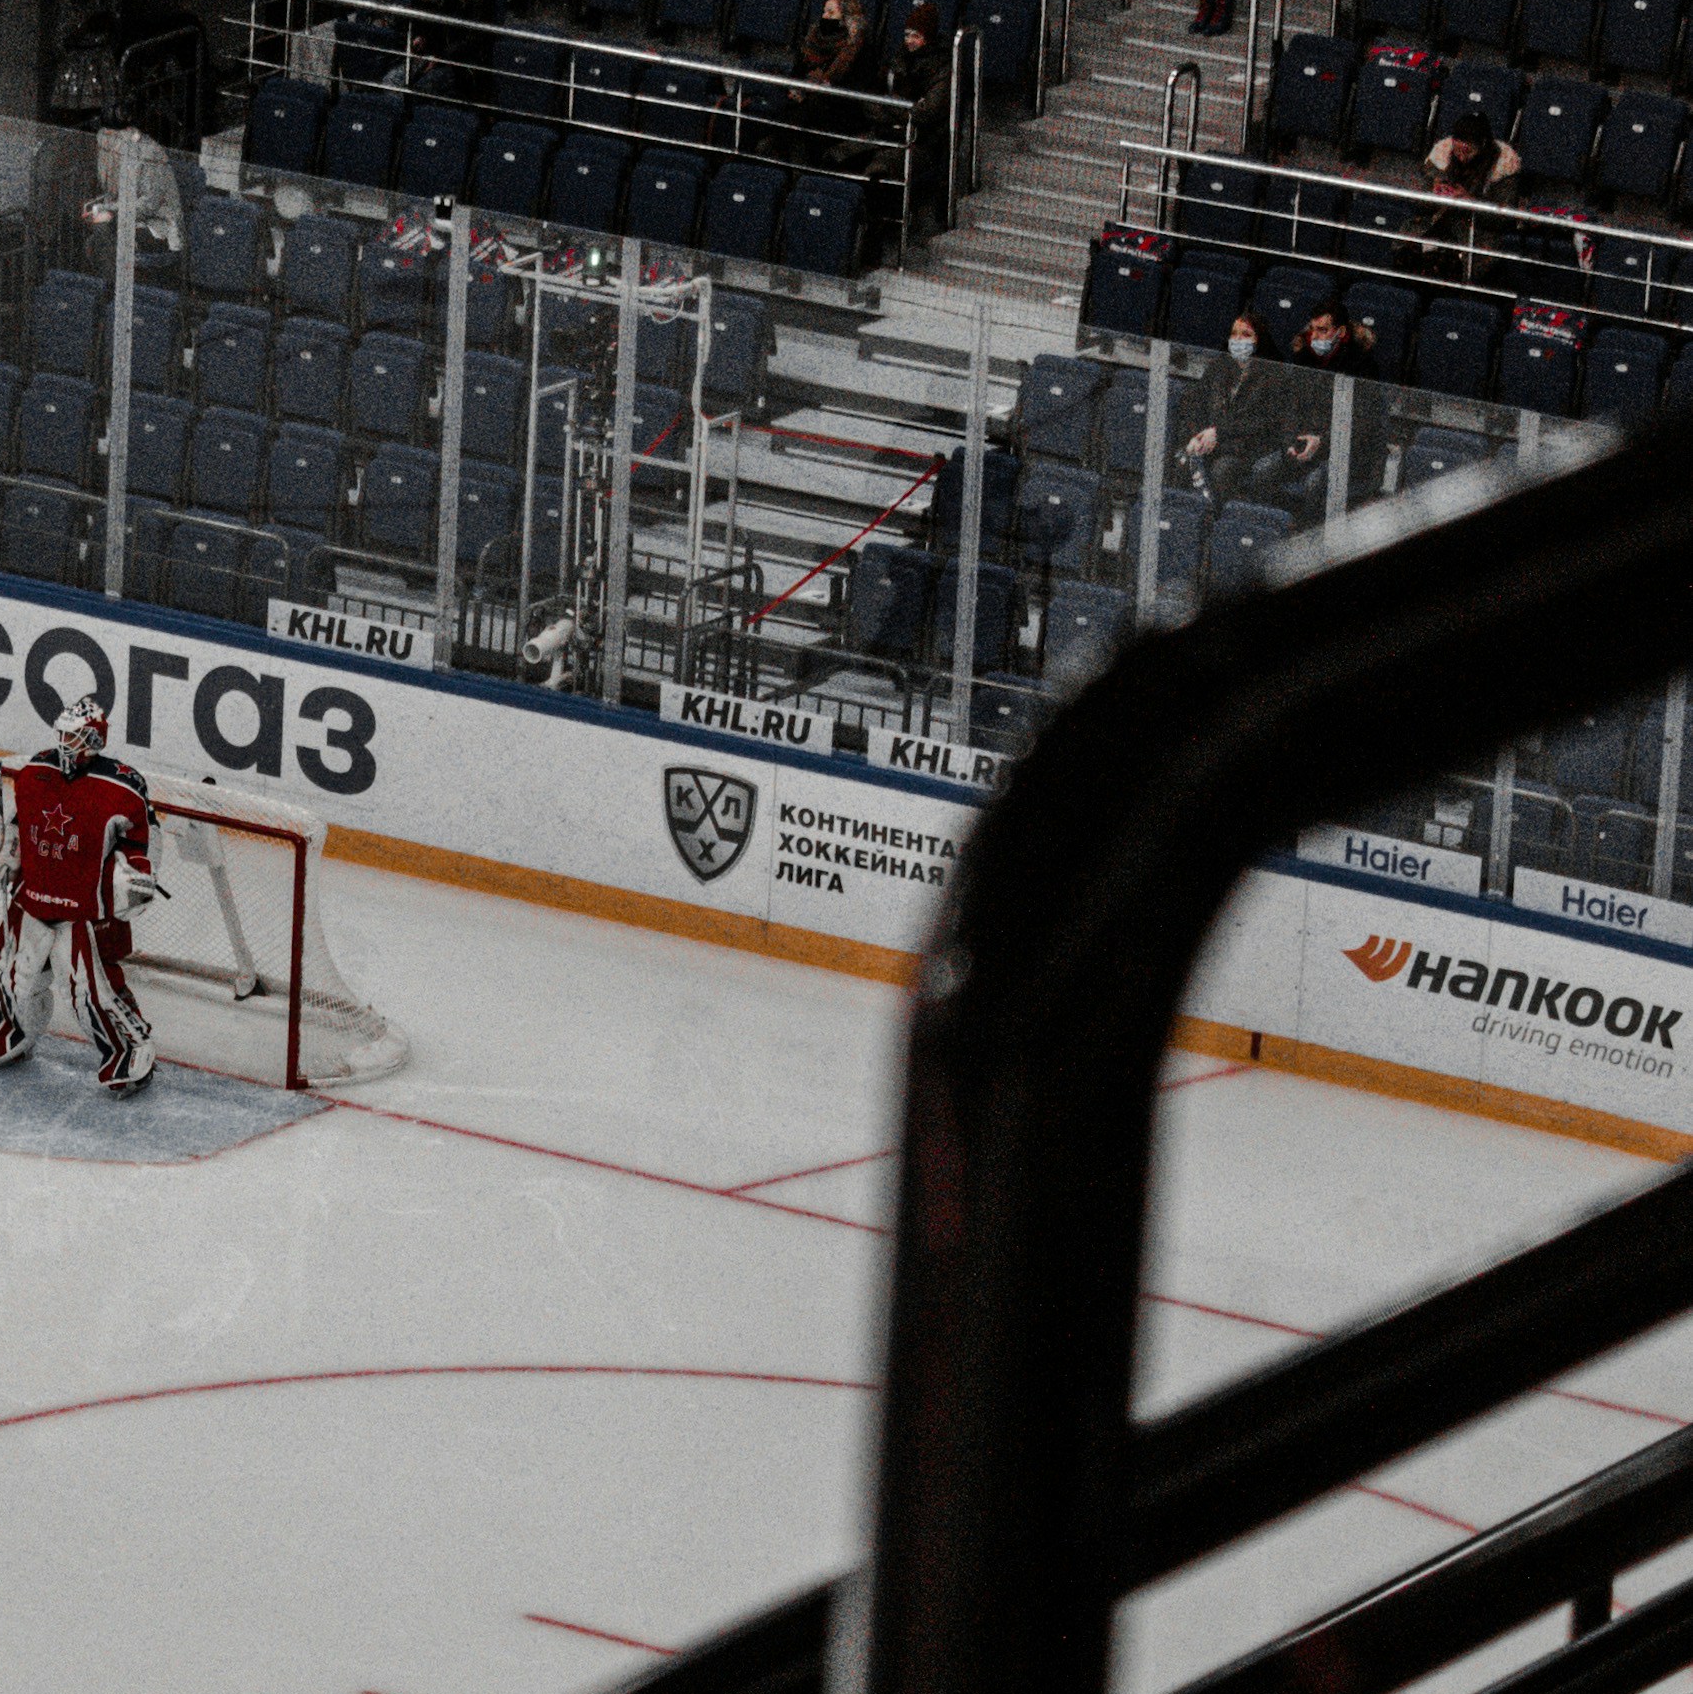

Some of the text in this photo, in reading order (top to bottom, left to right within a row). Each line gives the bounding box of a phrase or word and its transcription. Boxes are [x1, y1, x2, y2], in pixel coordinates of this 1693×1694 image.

[286, 610, 415, 661] KHL.RU
[680, 691, 812, 745] KHL.RU
[890, 737, 1011, 789] KHL.R
[29, 824, 80, 861] ЦСКА
[780, 804, 956, 859] КОНТИНЕНТА
[776, 862, 844, 894] ЛИГА
[778, 832, 945, 887] ХОККЕЙНАЯ
[1344, 836, 1432, 882] Haier
[1561, 885, 1649, 930] Haier
[1471, 1012, 1675, 1079] driving emotion
